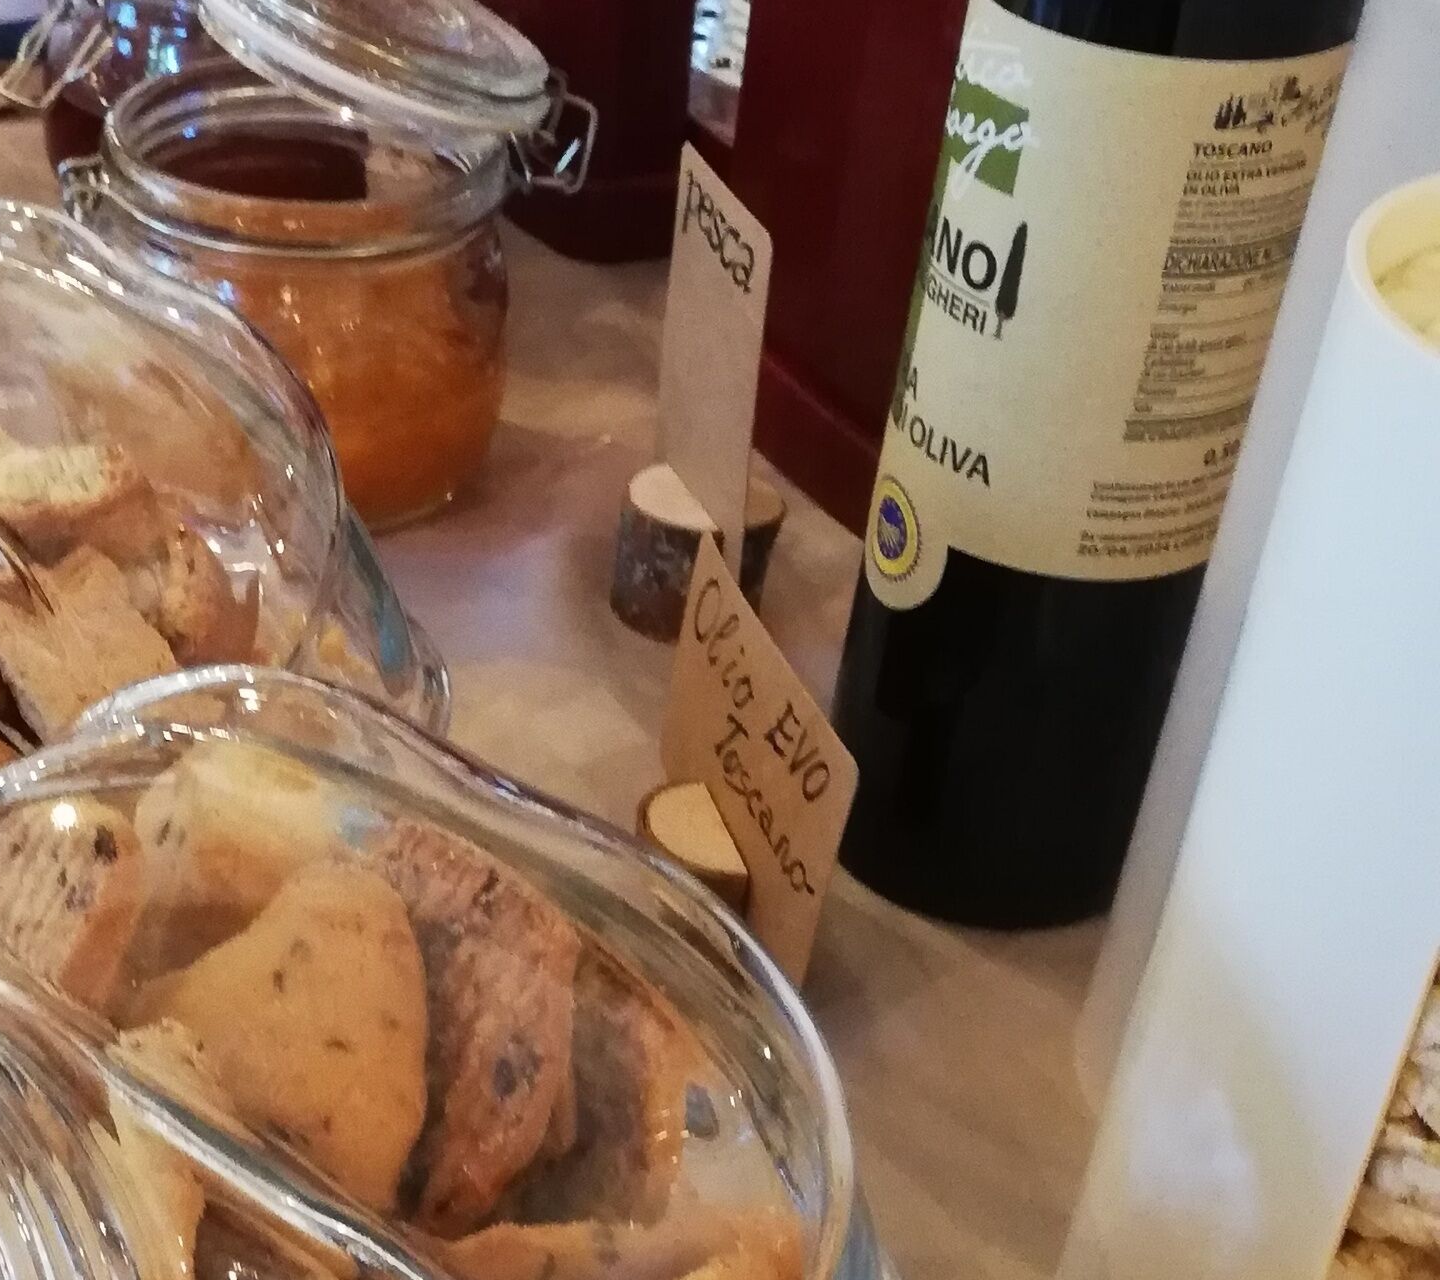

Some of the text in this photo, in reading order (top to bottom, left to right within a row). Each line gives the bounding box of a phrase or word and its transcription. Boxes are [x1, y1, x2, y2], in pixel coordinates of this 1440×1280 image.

[1186, 170, 1220, 182] OLIO
[1223, 167, 1263, 182] EXTRA
[1193, 139, 1274, 157] TOSCANO
[1201, 183, 1241, 197] OLIVA
[682, 170, 756, 296] pesca
[910, 415, 991, 487] OLIVA
[694, 577, 831, 803] Olio EVO
[714, 712, 816, 897] Toscano
